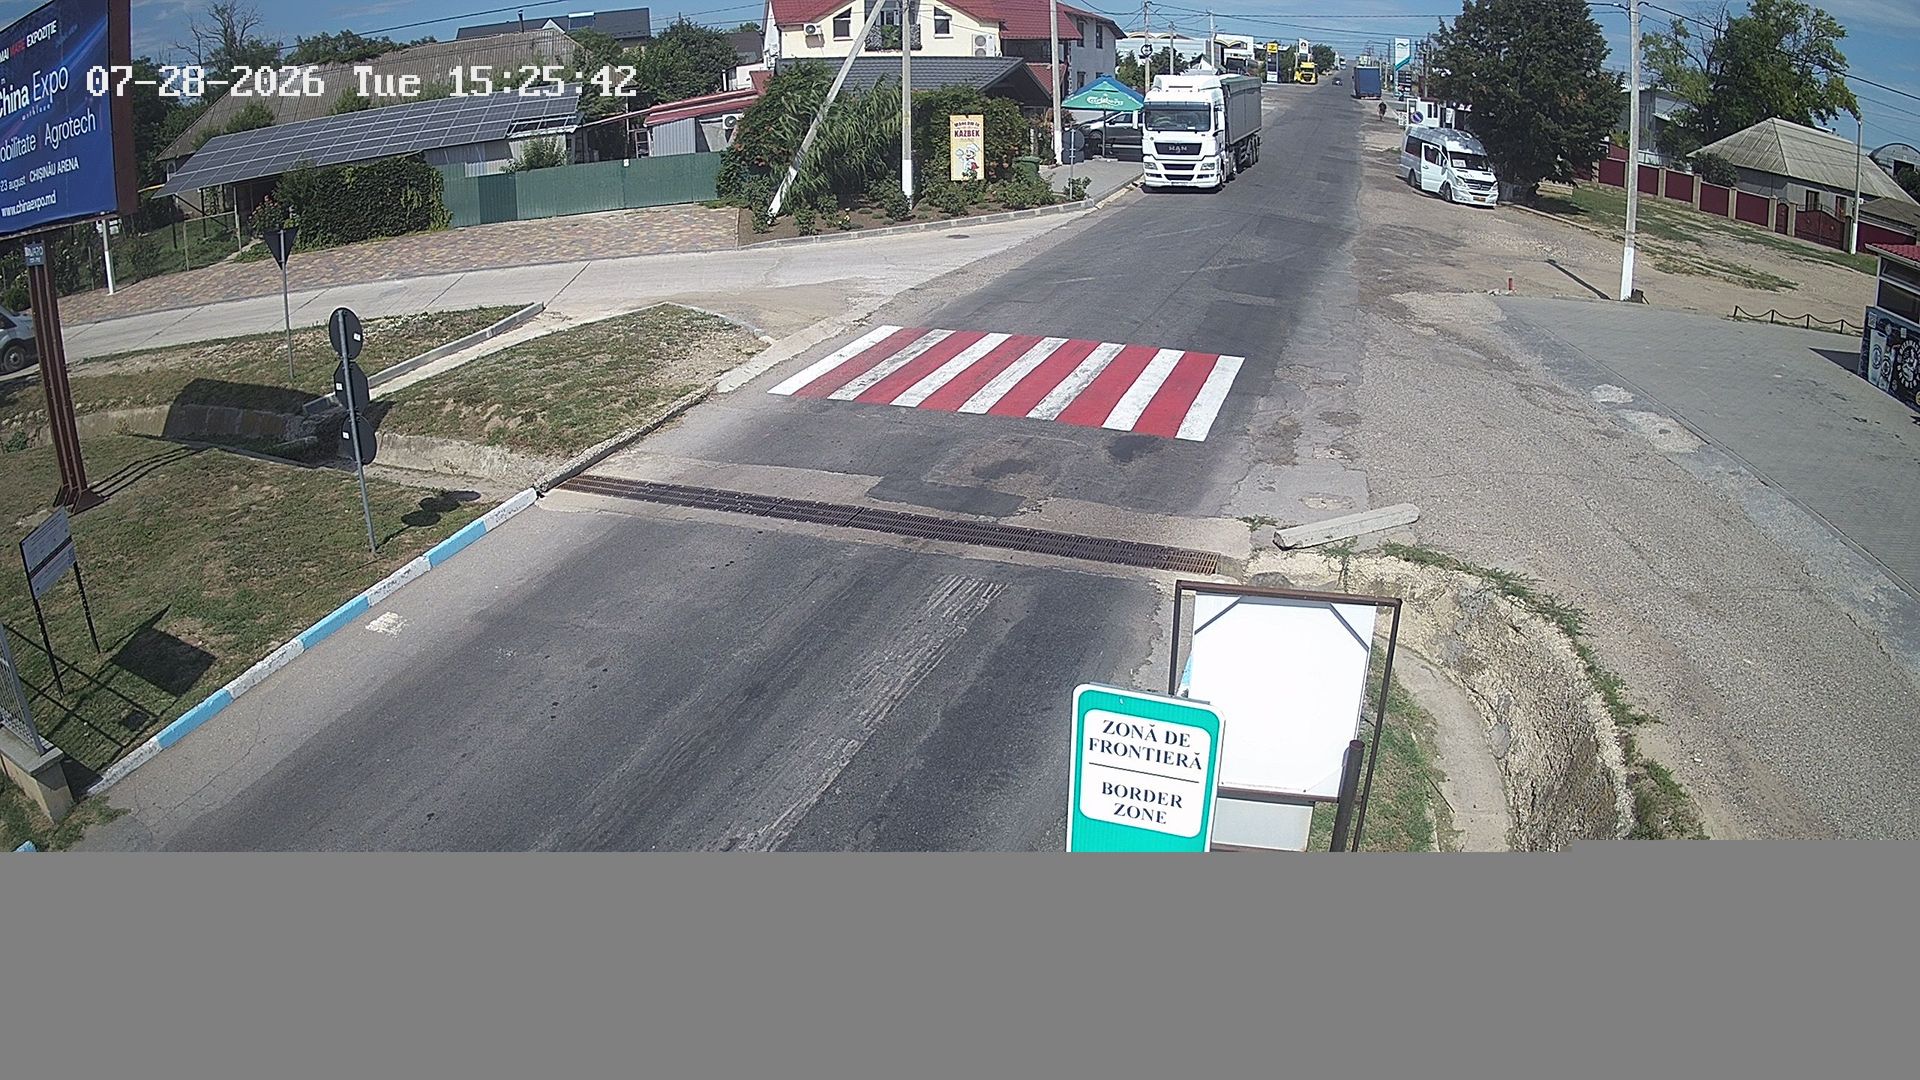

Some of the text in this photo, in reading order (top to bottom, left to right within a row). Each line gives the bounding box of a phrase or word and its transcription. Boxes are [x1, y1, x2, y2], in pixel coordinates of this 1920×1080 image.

[0, 85, 30, 118] hina
[33, 66, 69, 104] Expo
[0, 133, 36, 162] obilitate
[44, 107, 96, 150] Agrotech
[8, 176, 26, 191] august
[57, 156, 80, 174] ARENA
[1102, 719, 1191, 748] ZONĂ DE
[1089, 737, 1202, 770] FRONTIERĂ
[1102, 781, 1183, 809] BORDER
[1113, 802, 1168, 825] ZONE
